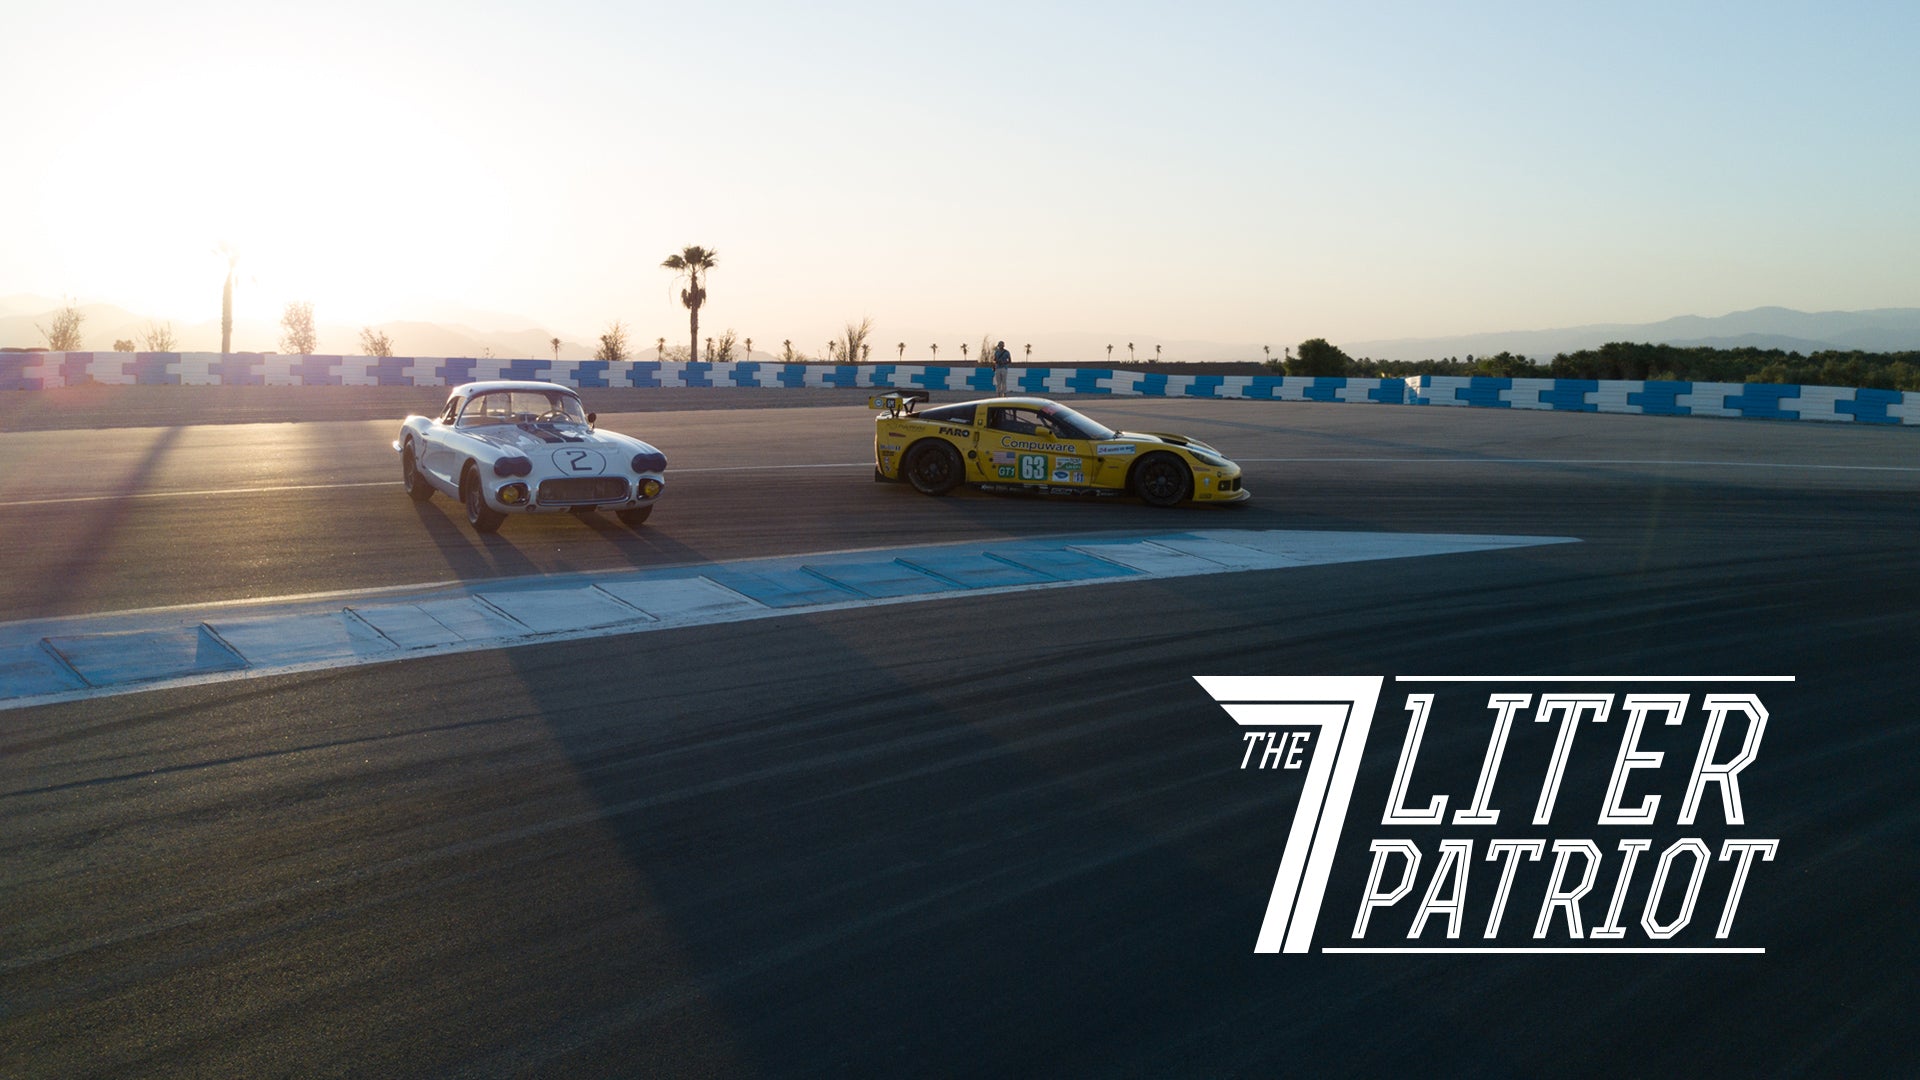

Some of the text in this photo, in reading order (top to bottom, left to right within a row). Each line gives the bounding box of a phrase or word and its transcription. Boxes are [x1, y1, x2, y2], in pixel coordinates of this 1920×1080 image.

[938, 426, 970, 438] FARO
[1001, 436, 1076, 453] Compuware
[566, 450, 593, 471] 2
[1022, 456, 1044, 479] 63
[999, 467, 1015, 477] GT1
